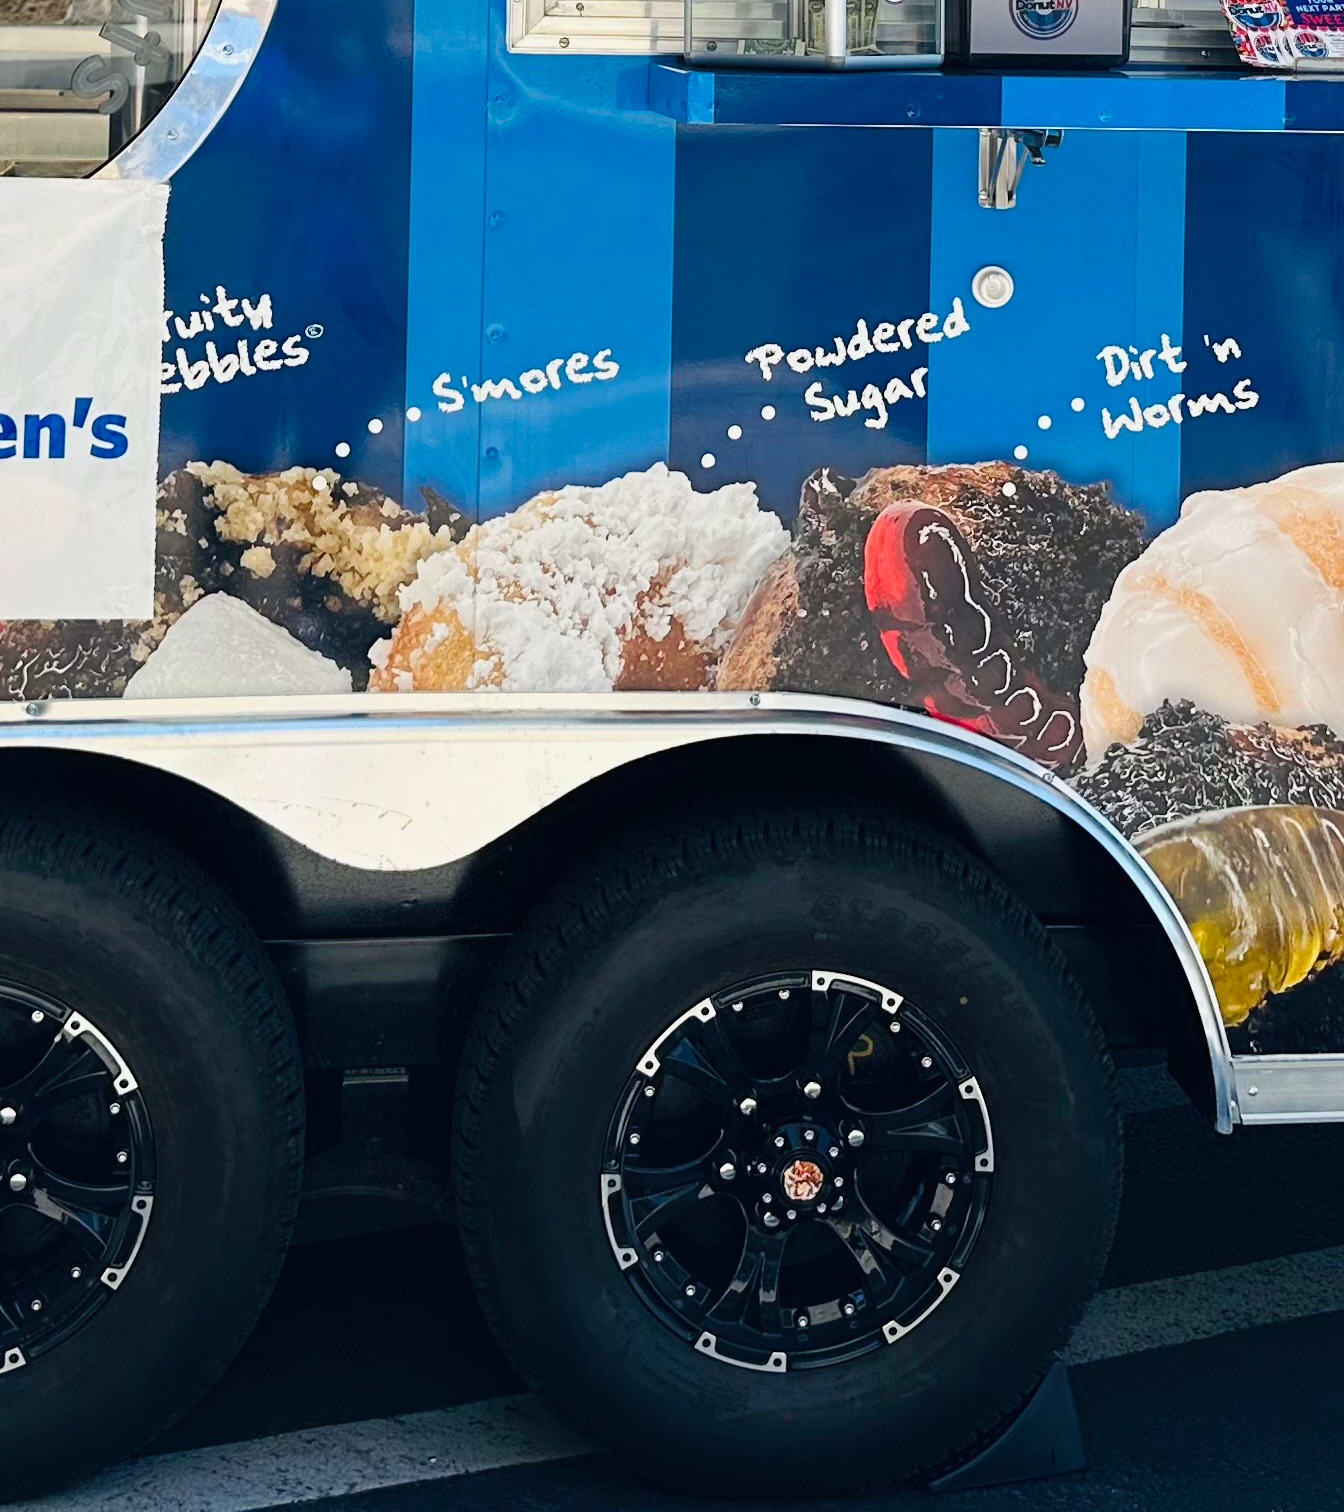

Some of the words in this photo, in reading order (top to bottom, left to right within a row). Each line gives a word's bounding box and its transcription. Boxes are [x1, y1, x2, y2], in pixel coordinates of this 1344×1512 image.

[1296, 5, 1319, 13] NEXT
[745, 297, 973, 381] Powdered
[1096, 337, 1186, 387] Dirt
[432, 345, 619, 414] S'mores
[804, 367, 930, 430] Sugar
[1100, 379, 1260, 441] Worms
